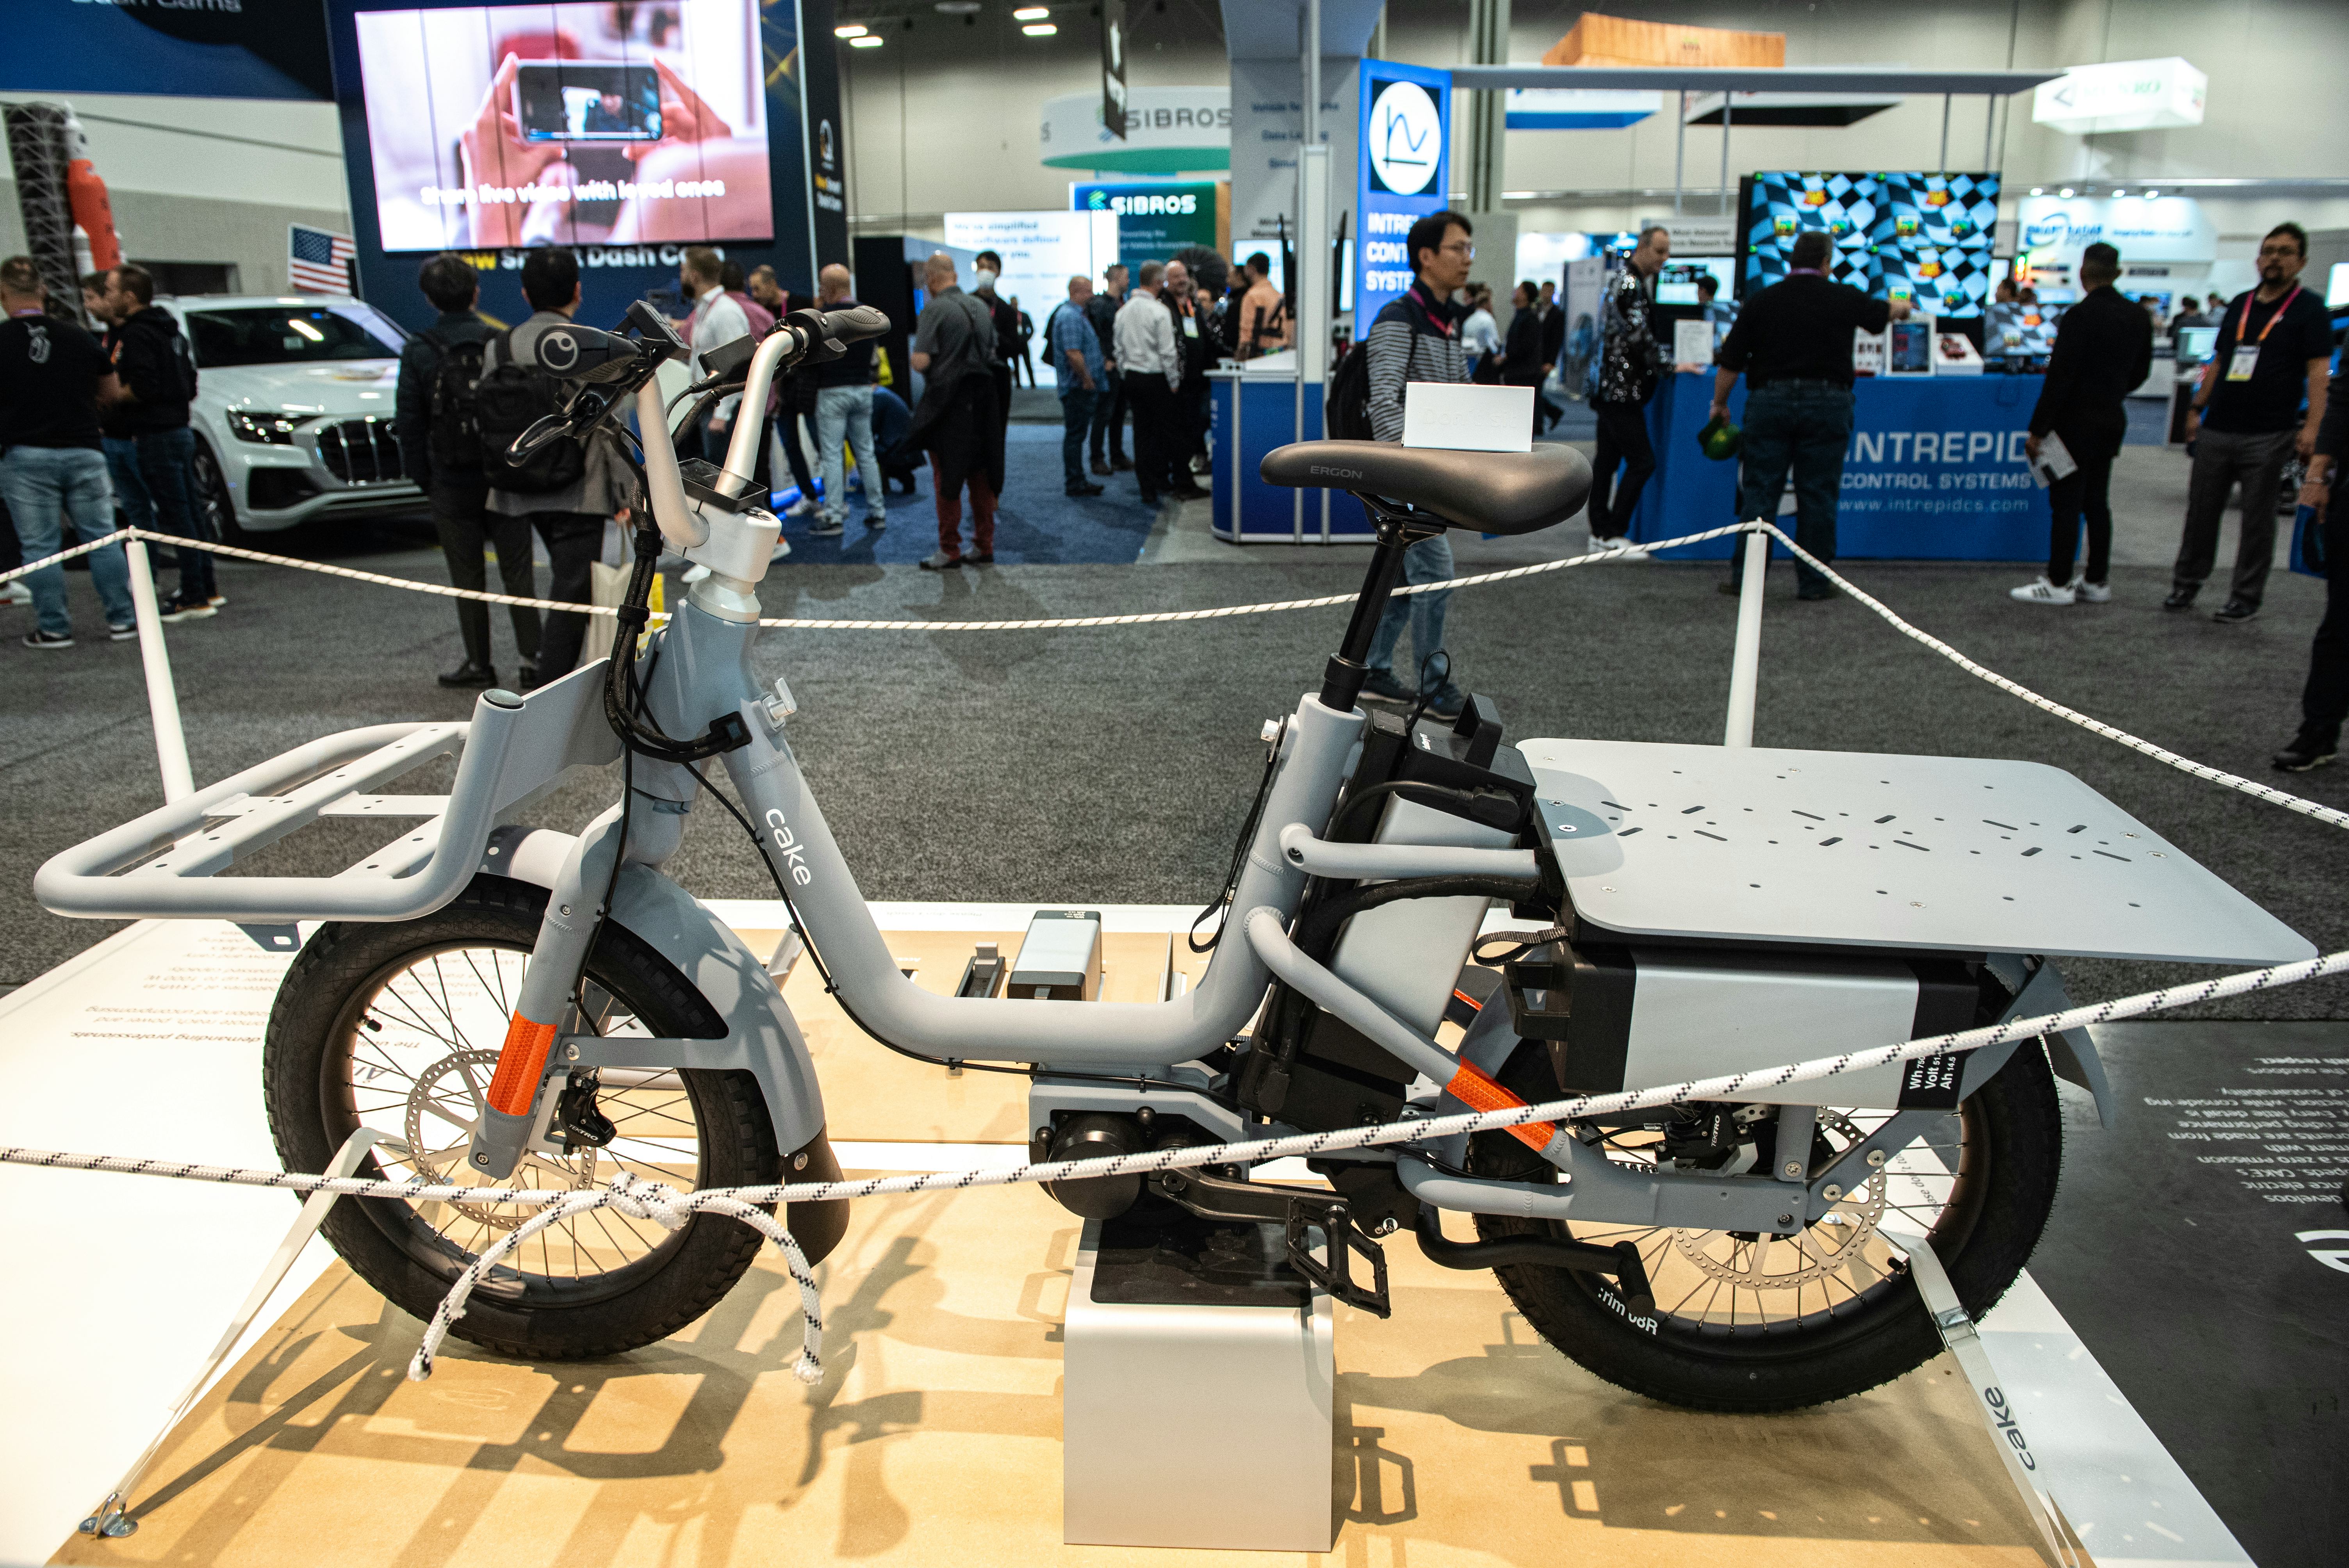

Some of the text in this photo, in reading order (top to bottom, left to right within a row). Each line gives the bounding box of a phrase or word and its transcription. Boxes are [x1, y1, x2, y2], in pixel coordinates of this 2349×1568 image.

[1126, 107, 1231, 130] SIBROS
[421, 179, 726, 205] Share live video with loved ones
[1110, 194, 1197, 216] SIBROS
[587, 247, 657, 267] Dash
[1844, 431, 2030, 463] NTREPID
[1310, 465, 1363, 479] ERGON
[1839, 472, 2031, 490] CONTROL SYSTEMS
[1838, 498, 2029, 513] www.intrepidcs.com
[766, 809, 811, 886] cake
[175, 1033, 261, 1044] demanding
[1909, 1056, 1925, 1089] Wh 750
[1924, 1054, 1942, 1089] Volt 51.
[1940, 1073, 1953, 1090] Ah
[2240, 1099, 2288, 1108] while
[2201, 1110, 2249, 1118] detail
[2249, 1110, 2290, 1119] little
[2288, 1108, 2337, 1118] Every
[569, 1123, 599, 1141] TEKTRO
[1711, 1114, 1720, 1147] TEKTRO
[2176, 1119, 2284, 1130] performance
[2166, 1131, 2212, 1142] from
[2211, 1131, 2262, 1141] made
[2263, 1131, 2293, 1140] are
[2262, 1144, 2304, 1153] with
[2276, 1156, 2317, 1164] zero
[2239, 1181, 2305, 1191] electric
[1984, 1386, 2036, 1471] cake
